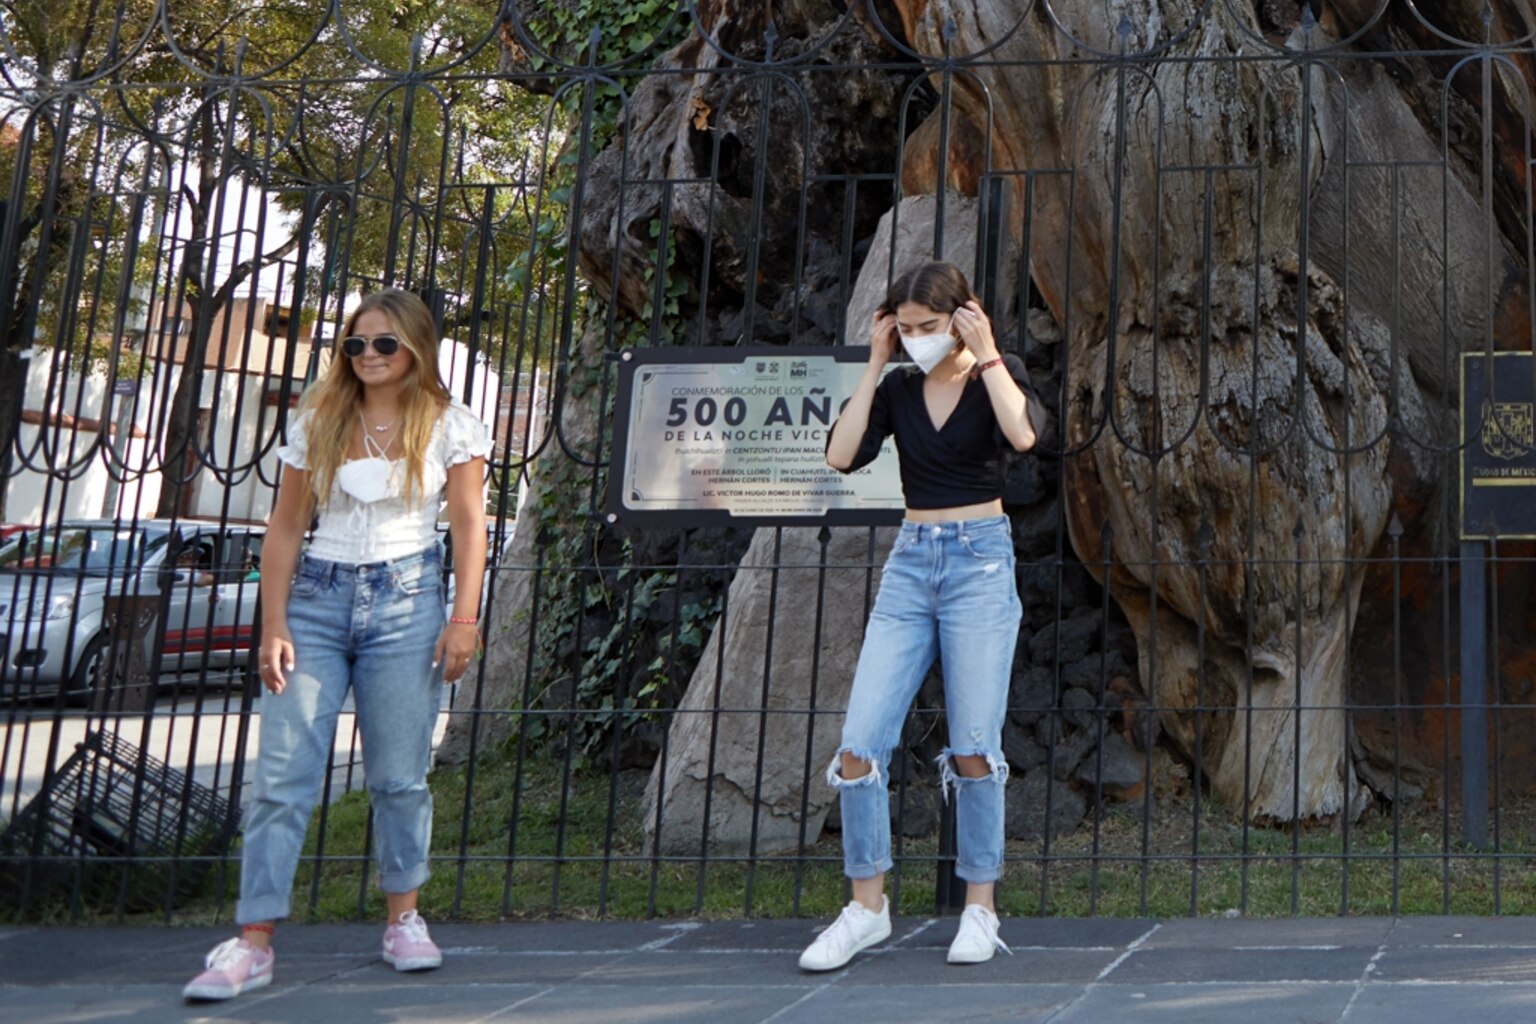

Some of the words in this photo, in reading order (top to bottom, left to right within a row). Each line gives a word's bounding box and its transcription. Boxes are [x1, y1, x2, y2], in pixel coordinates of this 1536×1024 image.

[672, 385, 767, 396] CONMEMORACIÓN
[769, 386, 782, 395] DE
[785, 386, 804, 395] LOS
[665, 396, 747, 427] 500
[763, 387, 853, 426] AÑ
[664, 430, 685, 441] DE
[693, 430, 713, 441] LA
[721, 430, 784, 441] NOCHE
